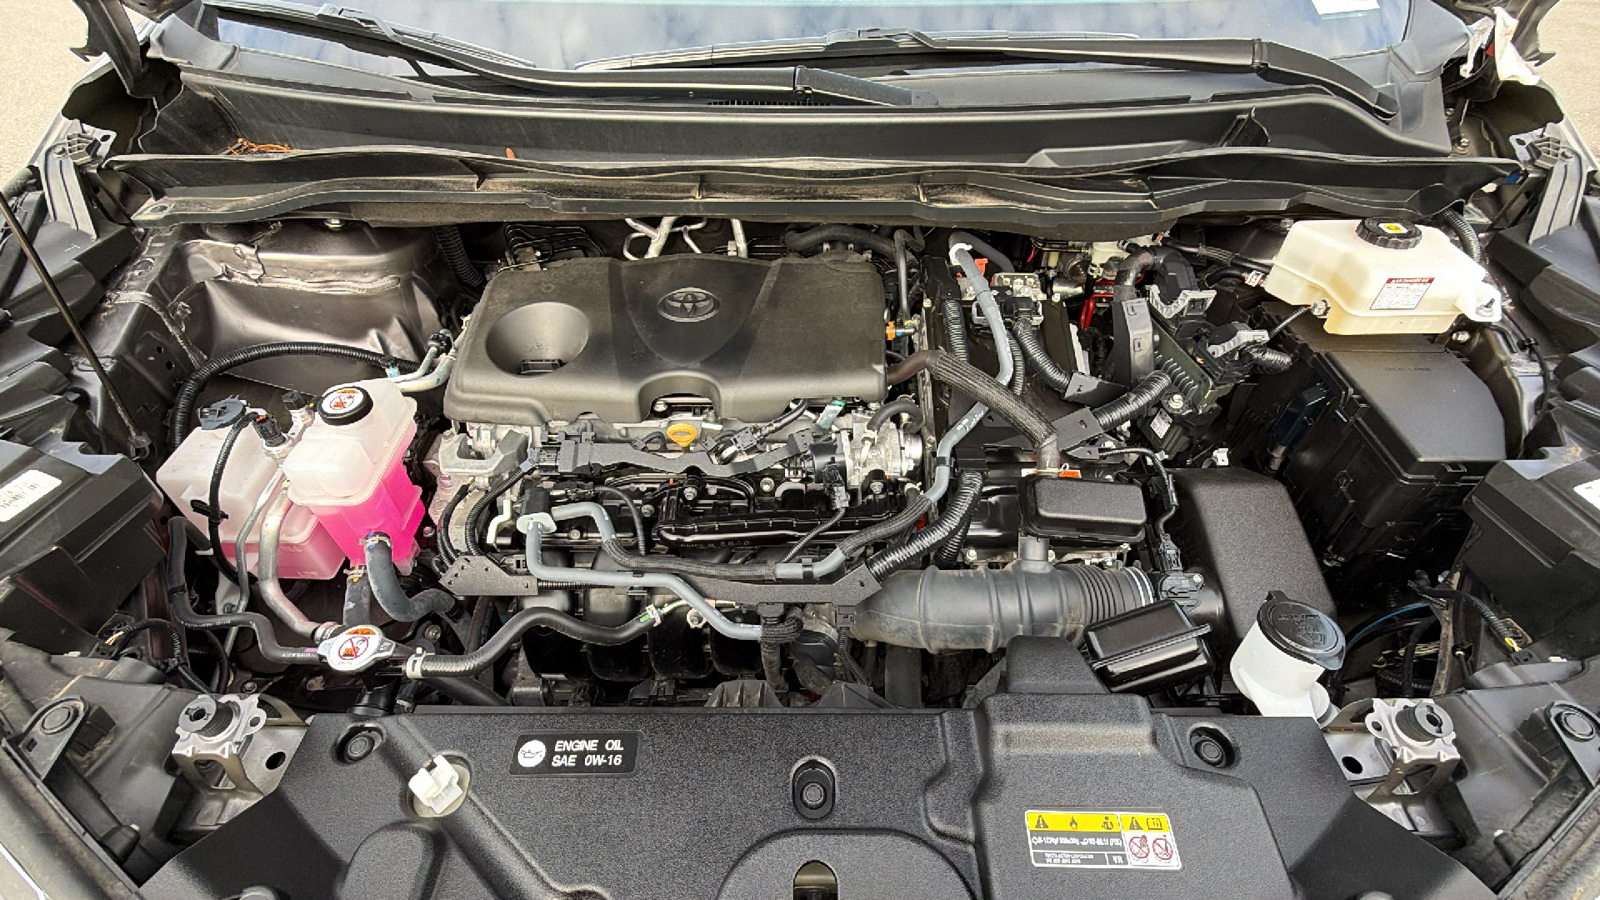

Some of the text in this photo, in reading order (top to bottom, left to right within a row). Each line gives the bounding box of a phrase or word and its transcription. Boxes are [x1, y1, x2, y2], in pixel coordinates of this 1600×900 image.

[554, 739, 624, 752] ENGINE OIL
[551, 754, 622, 767] SAE 0W-16
